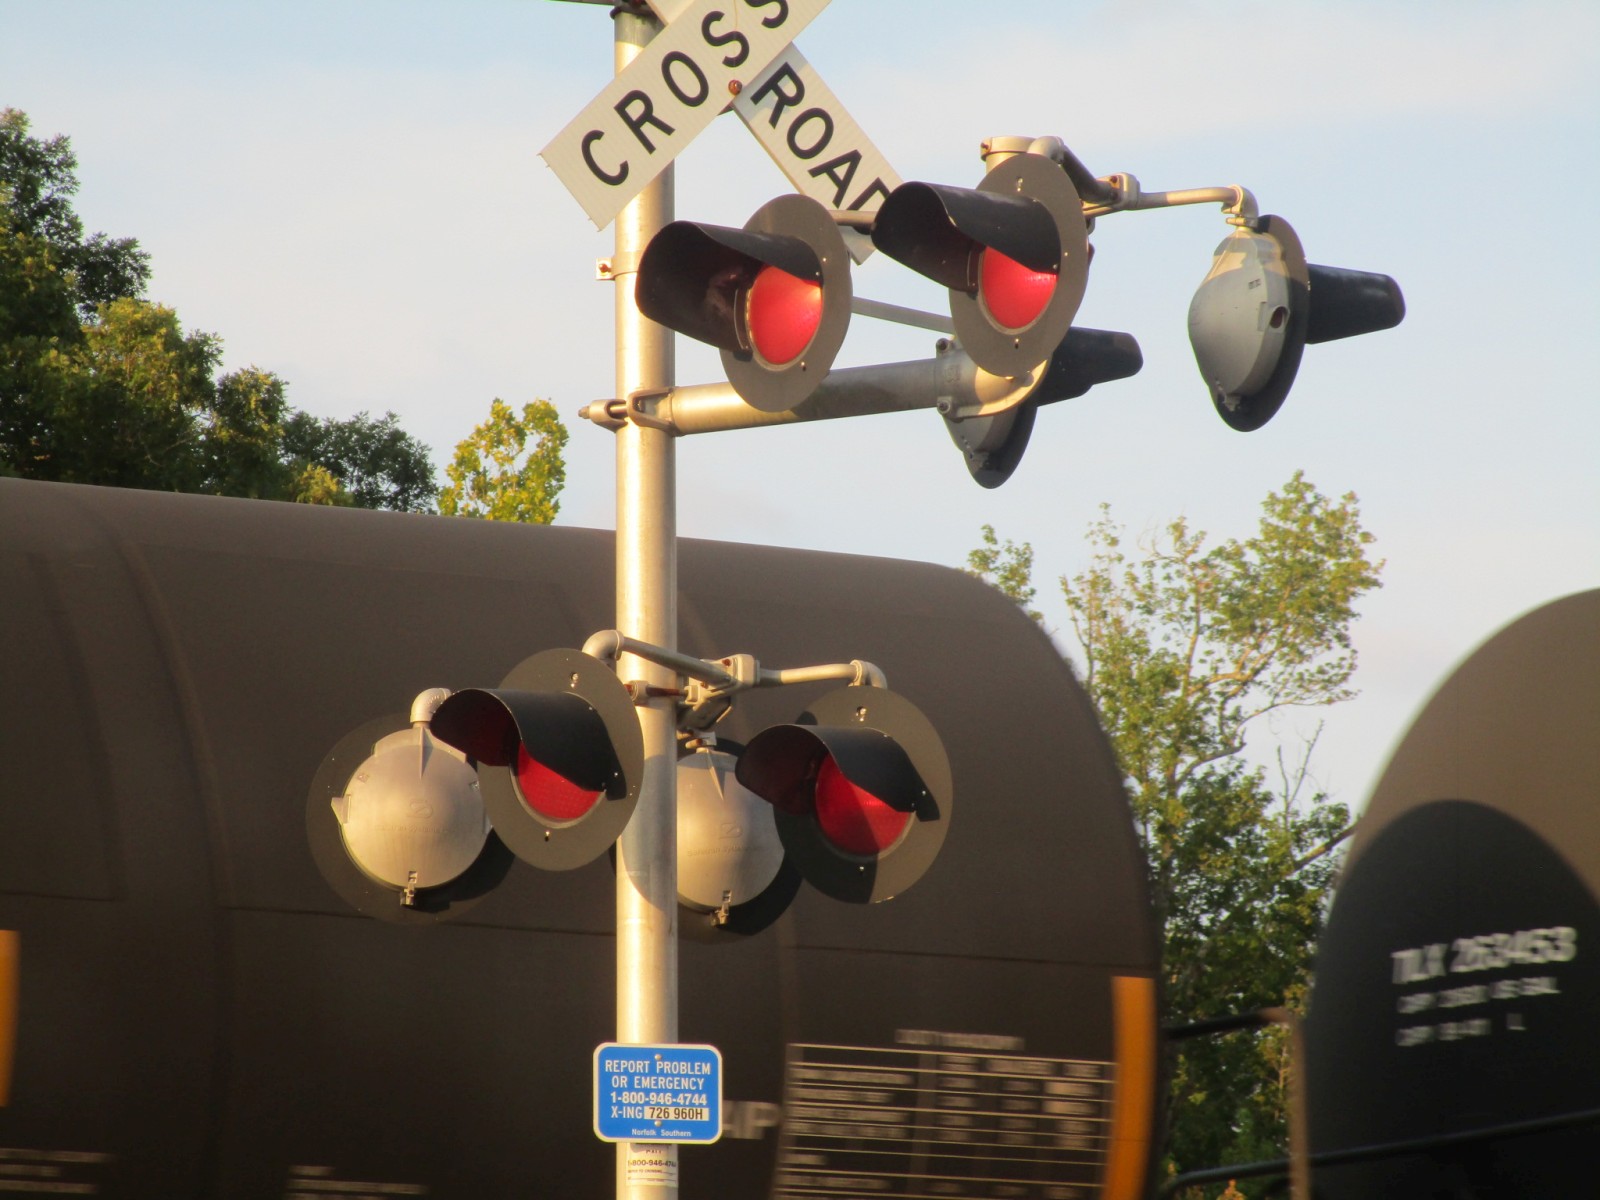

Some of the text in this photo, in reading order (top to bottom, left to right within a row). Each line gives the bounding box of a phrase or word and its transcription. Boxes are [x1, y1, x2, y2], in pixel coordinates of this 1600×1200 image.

[1450, 927, 1578, 973] 263453
[605, 1060, 711, 1075] REPORT PROBLEM
[611, 1075, 705, 1090] OR EMERGENCY
[610, 1091, 707, 1106] 1-800-946-4744
[611, 1105, 703, 1120] X-ING 726 960H
